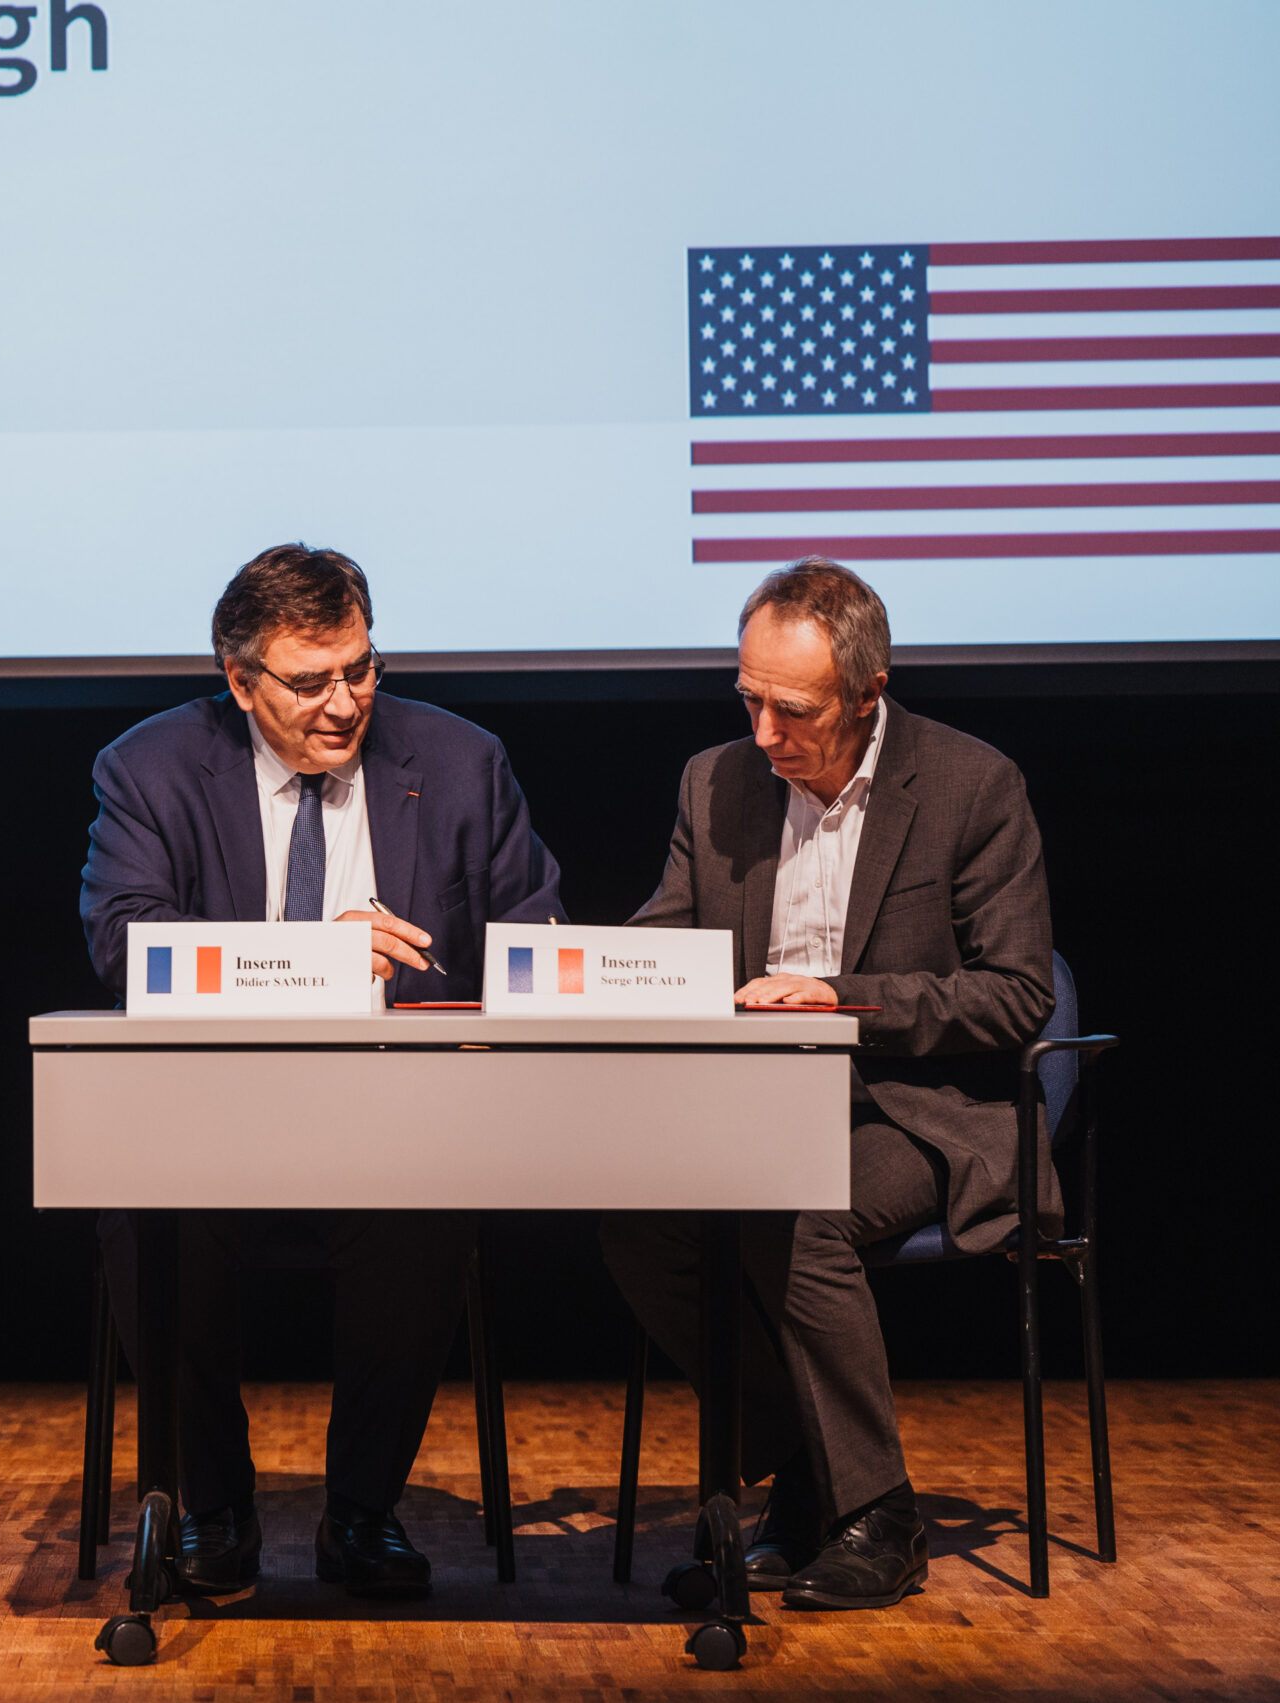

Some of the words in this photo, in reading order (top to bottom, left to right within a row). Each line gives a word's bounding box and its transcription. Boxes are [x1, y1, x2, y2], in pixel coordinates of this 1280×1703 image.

[236, 956, 292, 970] Inserm
[601, 955, 657, 969] Inserm
[236, 977, 269, 987] Didier
[273, 977, 329, 987] SAMUEL
[600, 976, 632, 987] Serge
[635, 975, 687, 986] PICAUD
